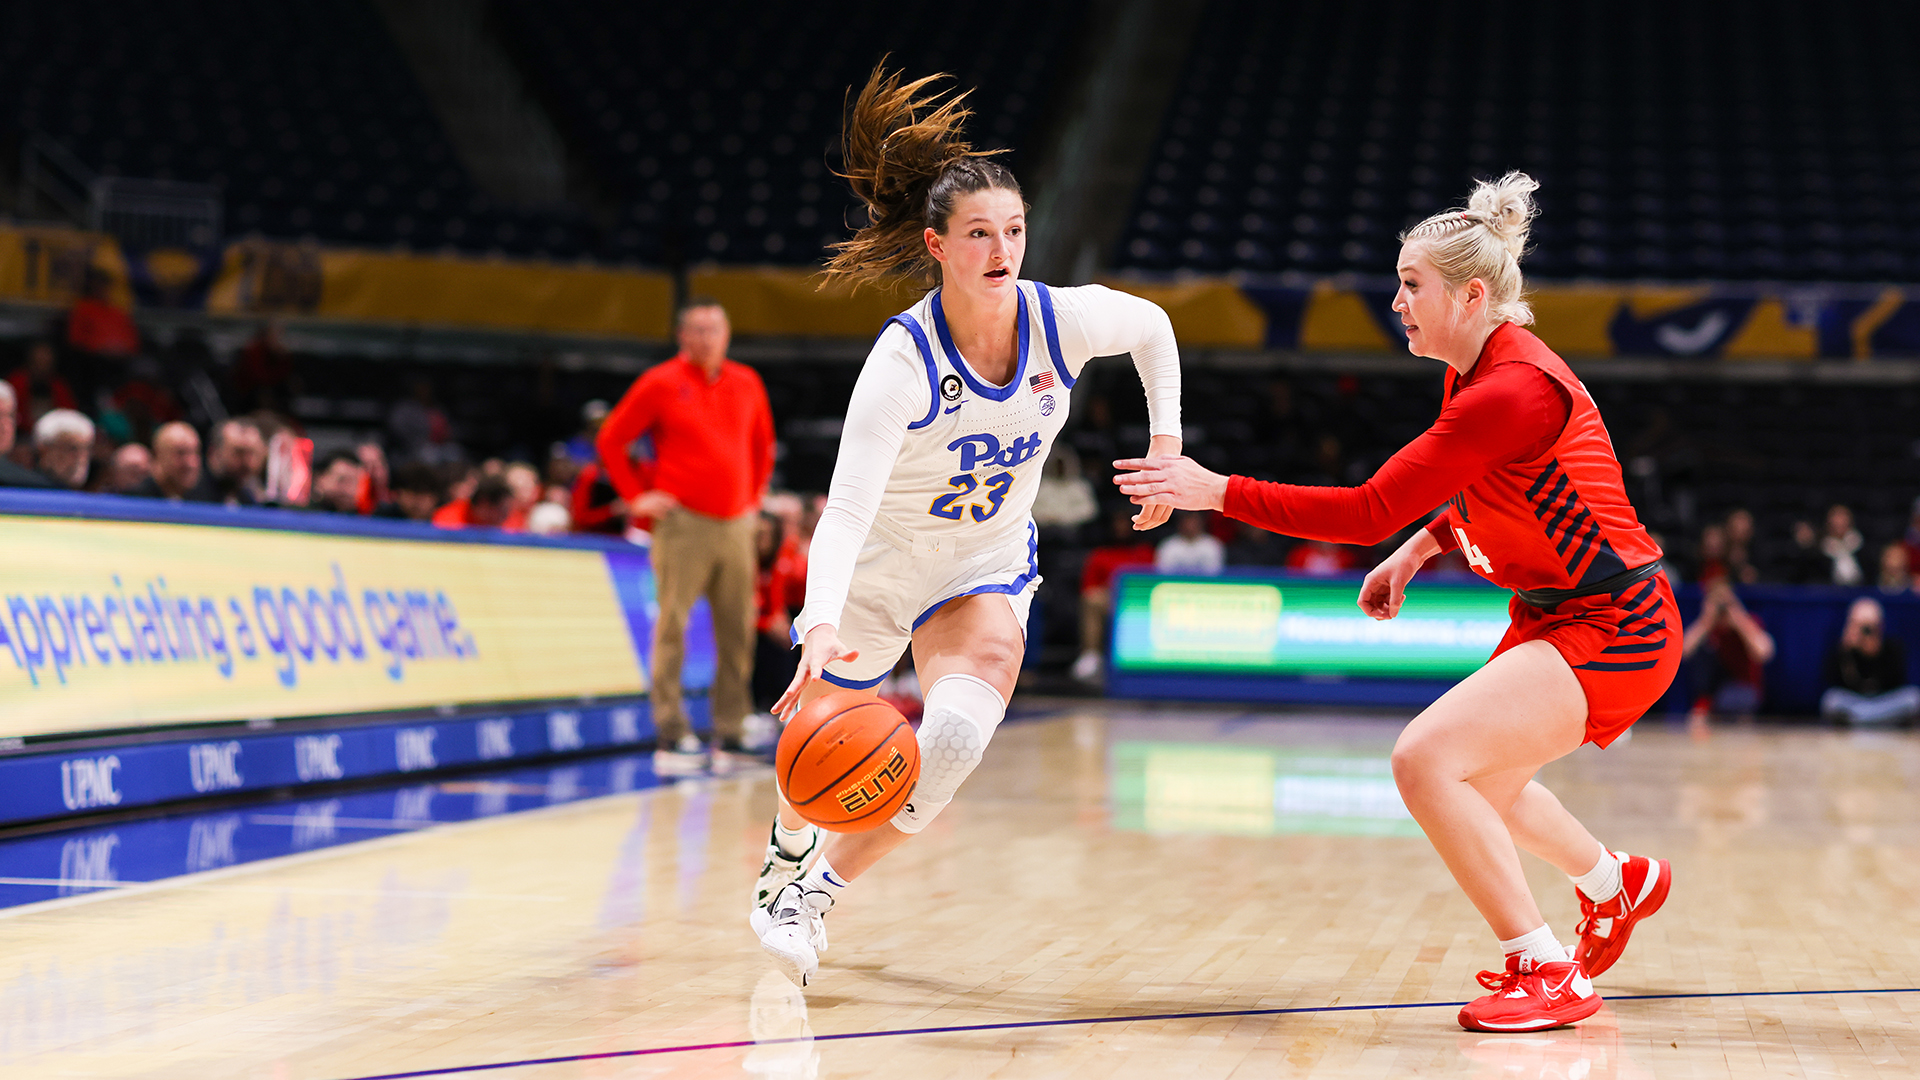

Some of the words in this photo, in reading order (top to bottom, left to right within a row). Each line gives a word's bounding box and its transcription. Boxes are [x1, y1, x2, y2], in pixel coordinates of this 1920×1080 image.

[947, 431, 1042, 471] Pitt
[928, 471, 1016, 523] 23
[1455, 528, 1494, 574] 4
[229, 596, 258, 659] a
[253, 561, 367, 688] good
[363, 588, 478, 681] game.
[61, 755, 123, 811] UPMC
[189, 740, 244, 793] UPMC
[294, 733, 345, 782] UPMC
[838, 752, 908, 814] ELITE
